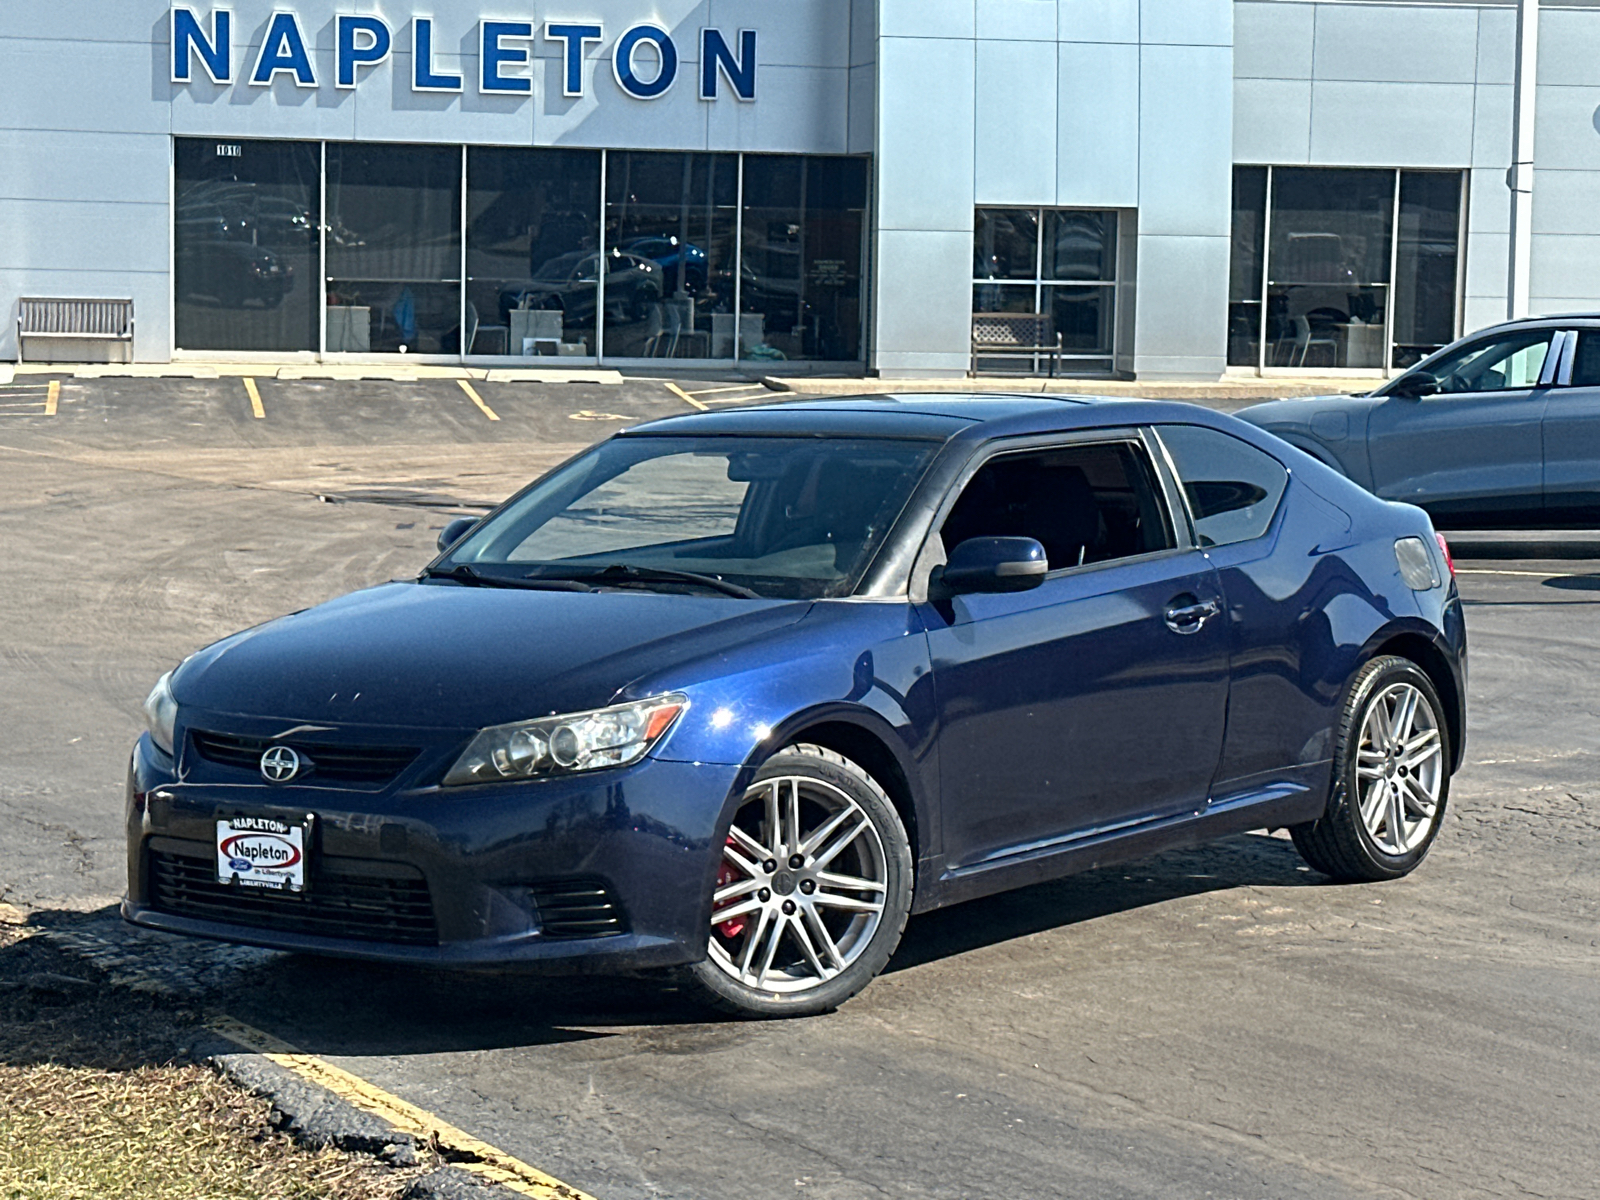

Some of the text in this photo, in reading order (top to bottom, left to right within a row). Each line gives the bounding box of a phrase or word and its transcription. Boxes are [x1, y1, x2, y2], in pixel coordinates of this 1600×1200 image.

[170, 6, 757, 101] NAPLETON
[217, 144, 242, 157] 1010
[233, 818, 283, 833] NAPLETON
[234, 841, 289, 861] Napleton
